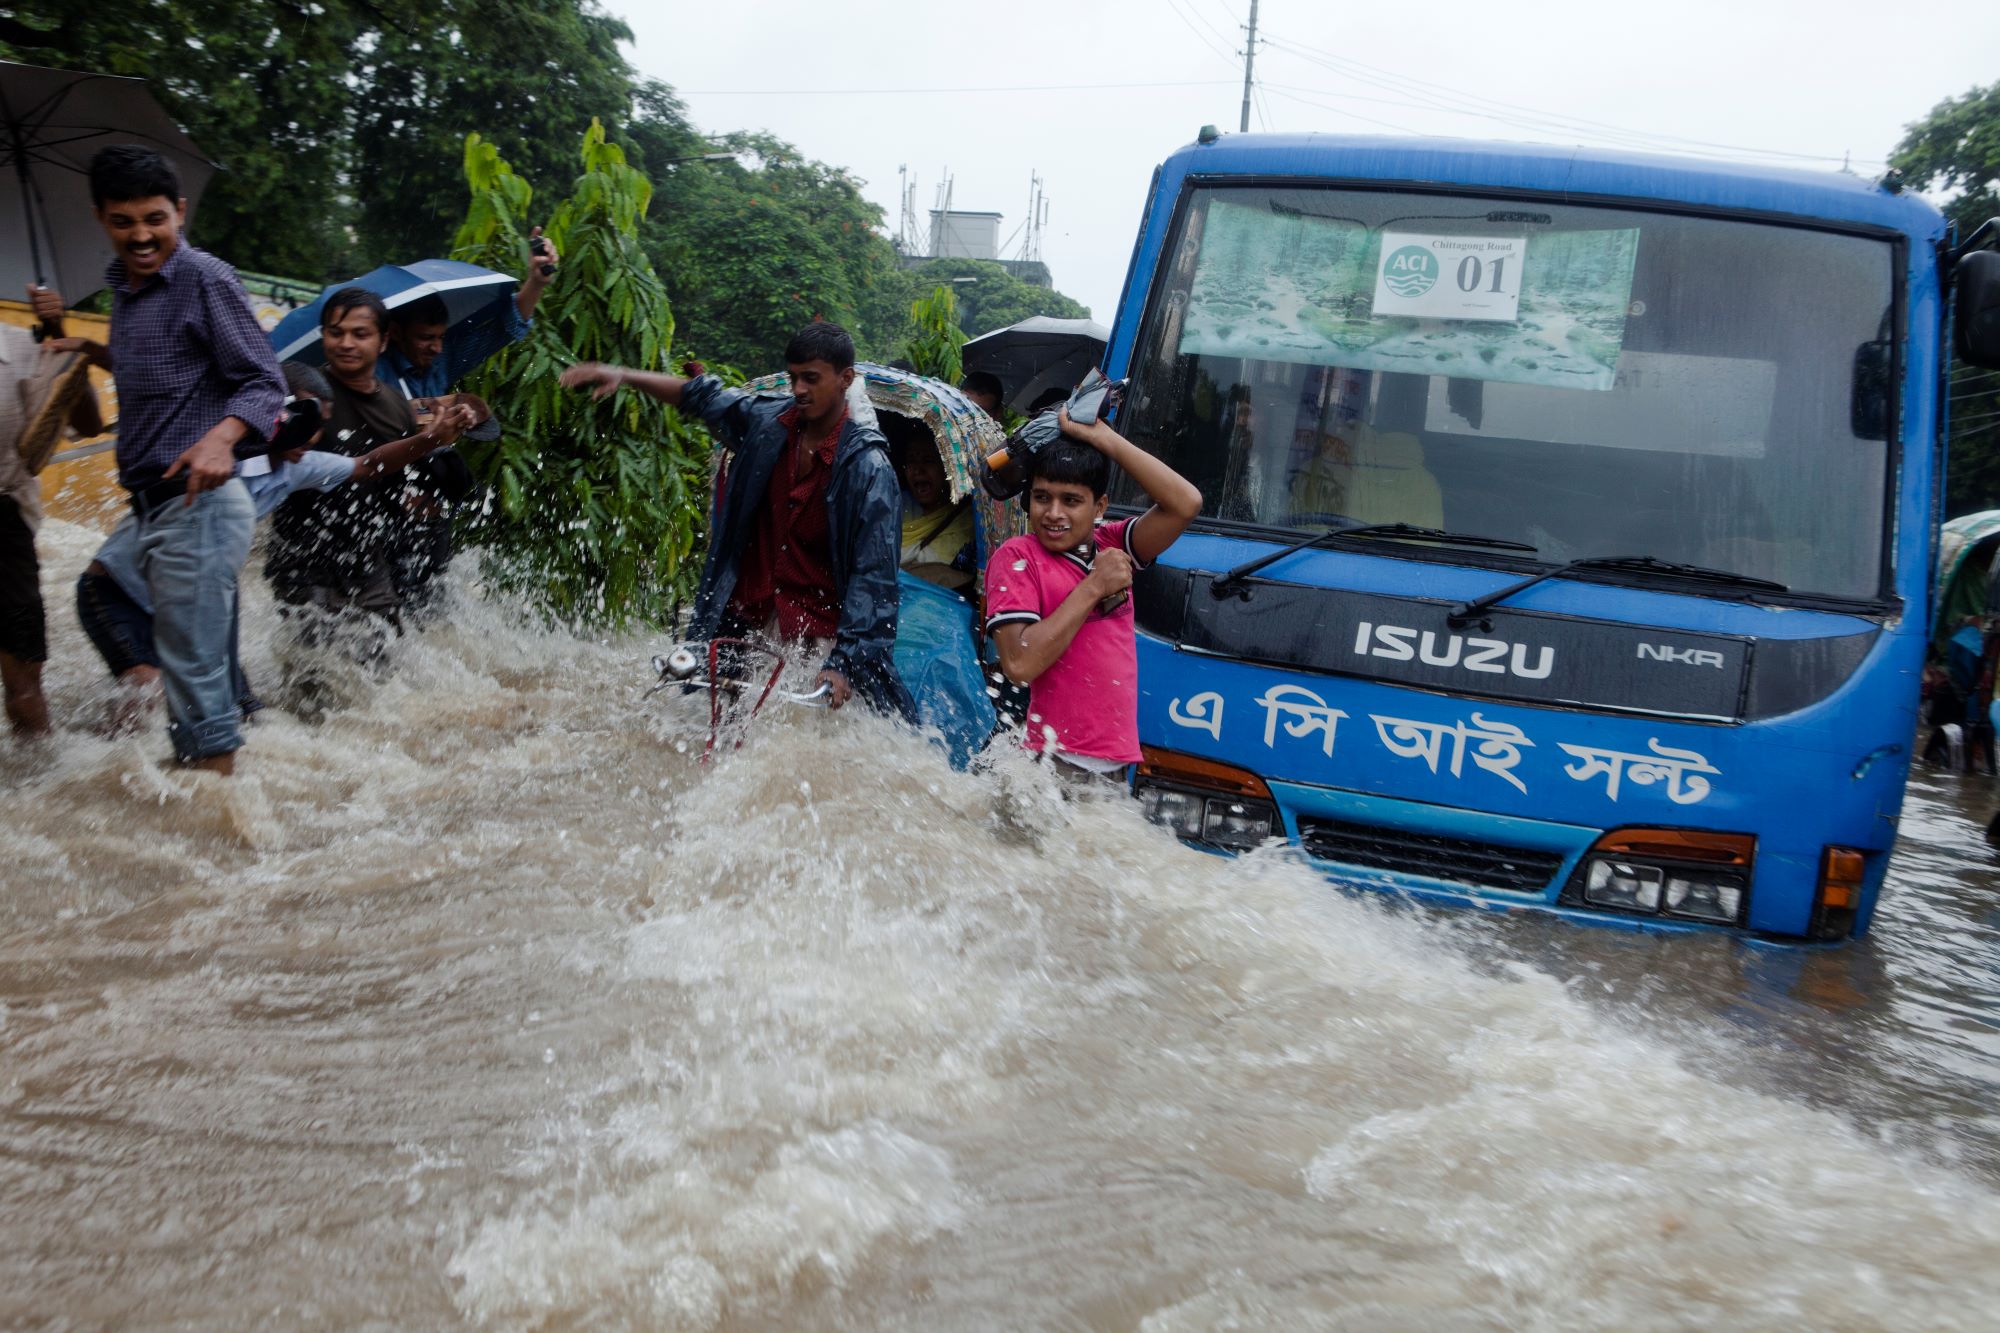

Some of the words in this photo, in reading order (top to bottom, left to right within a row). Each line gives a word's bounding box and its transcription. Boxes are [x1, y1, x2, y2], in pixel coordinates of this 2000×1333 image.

[1432, 240, 1484, 251] Chittagong
[1487, 242, 1512, 251] Road
[1392, 254, 1428, 271] ACI
[1457, 255, 1506, 293] 01
[1354, 621, 1555, 679] ISUZU
[1637, 642, 1724, 669] NKR
[1168, 691, 1225, 742] এ
[1253, 684, 1350, 759] সি
[1368, 712, 1537, 795] আই
[1556, 737, 1723, 805] সল্ট
